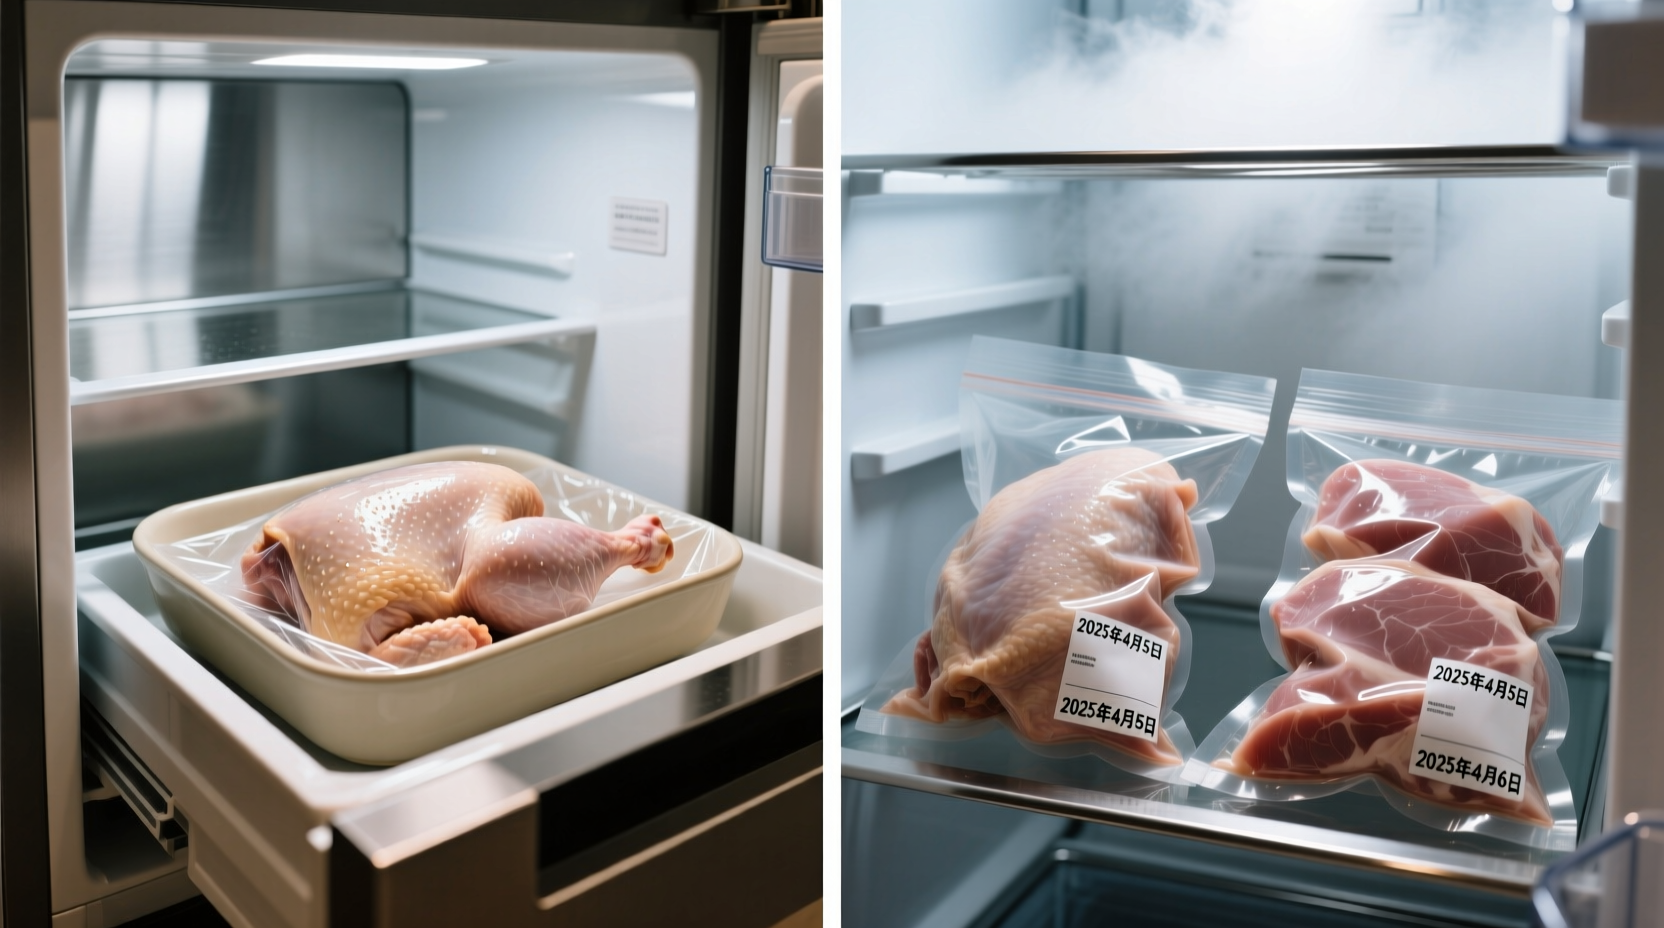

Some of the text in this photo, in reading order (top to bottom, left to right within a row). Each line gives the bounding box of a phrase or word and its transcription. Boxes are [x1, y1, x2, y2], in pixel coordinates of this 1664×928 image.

[1077, 617, 1162, 660] 2025年4月5日
[1433, 665, 1528, 709] 2025年4月5日
[1060, 697, 1156, 737] 2025年4月5日
[1415, 749, 1521, 795] 2025年4月6日
